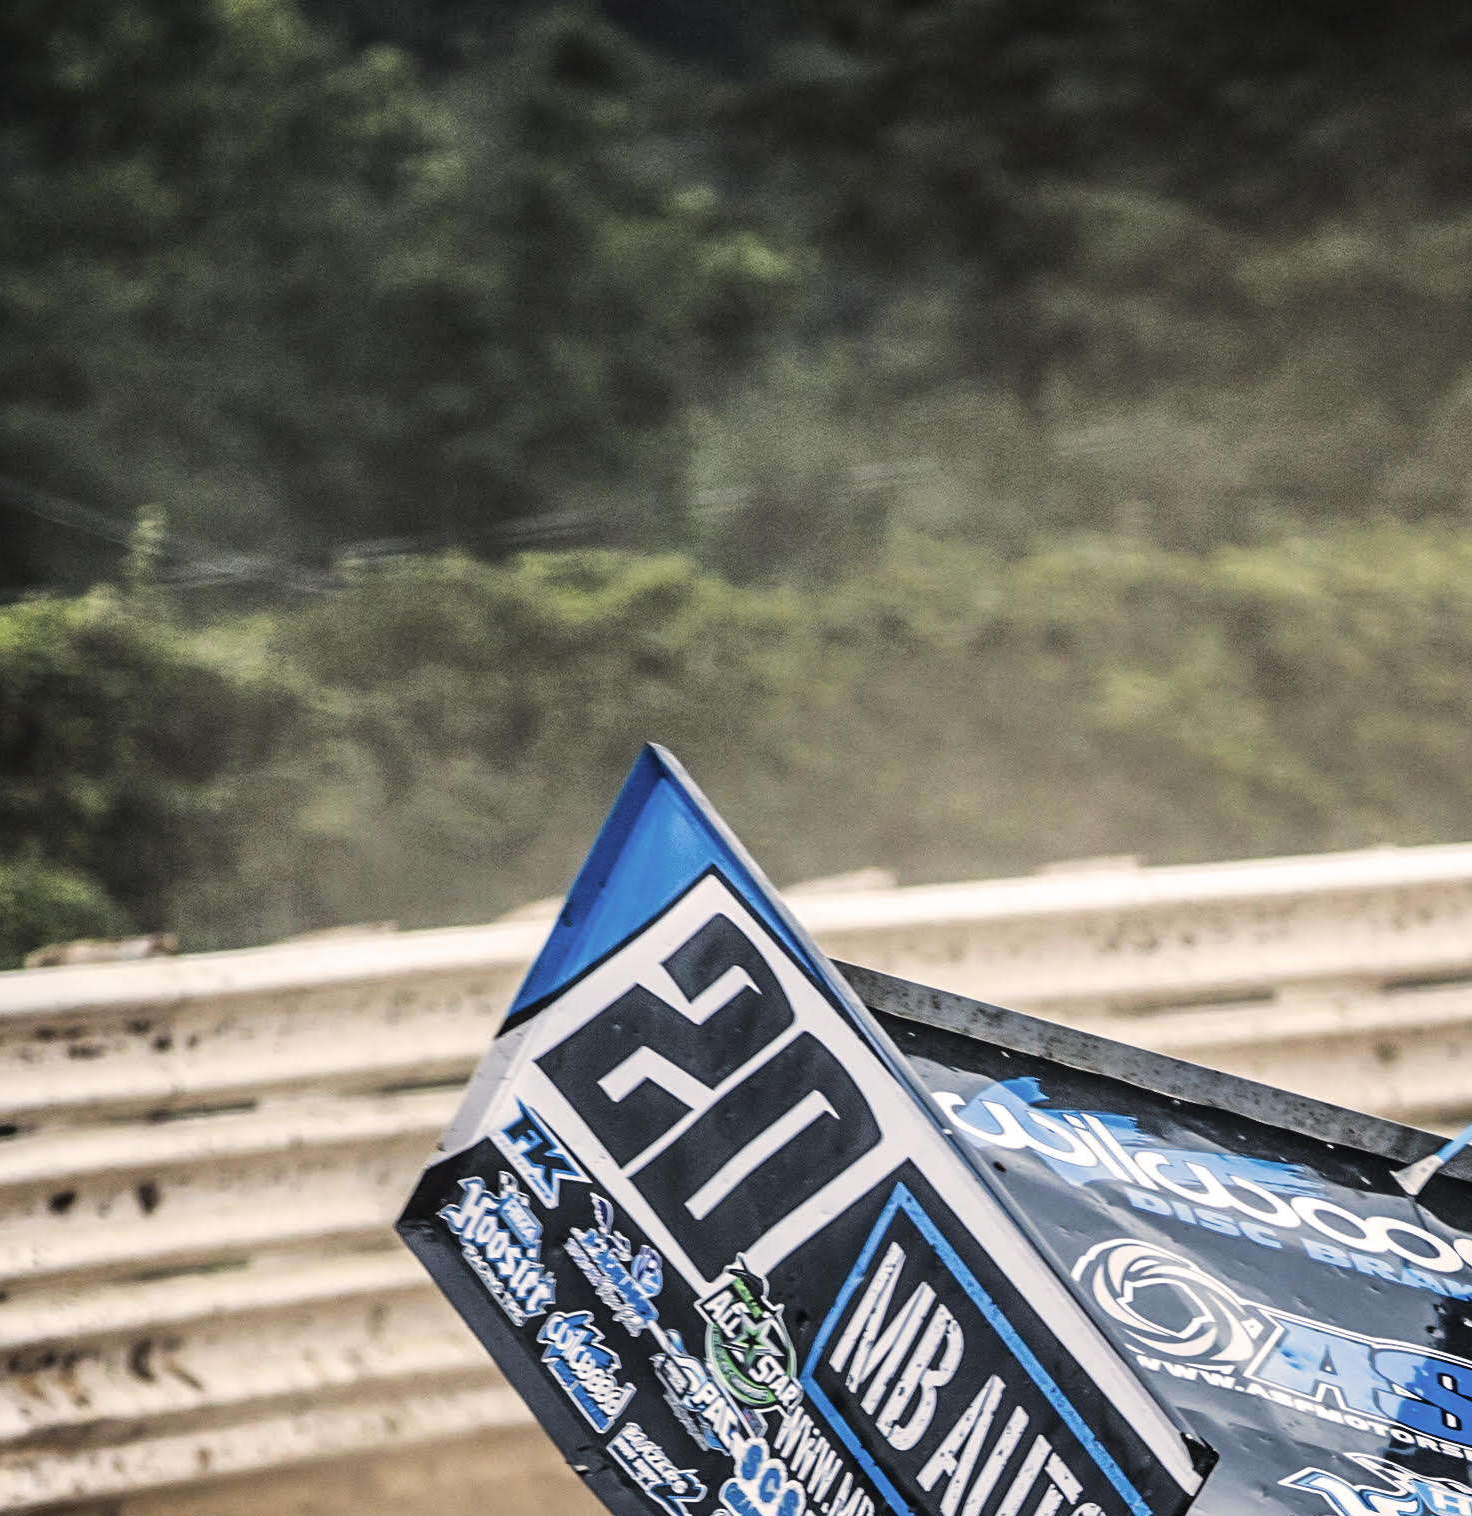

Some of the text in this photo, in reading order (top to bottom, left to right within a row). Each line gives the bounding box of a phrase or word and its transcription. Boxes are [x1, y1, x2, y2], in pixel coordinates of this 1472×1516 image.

[533, 912, 883, 1283] 20
[1125, 1186, 1283, 1249] DISC
[829, 1241, 964, 1451] MB
